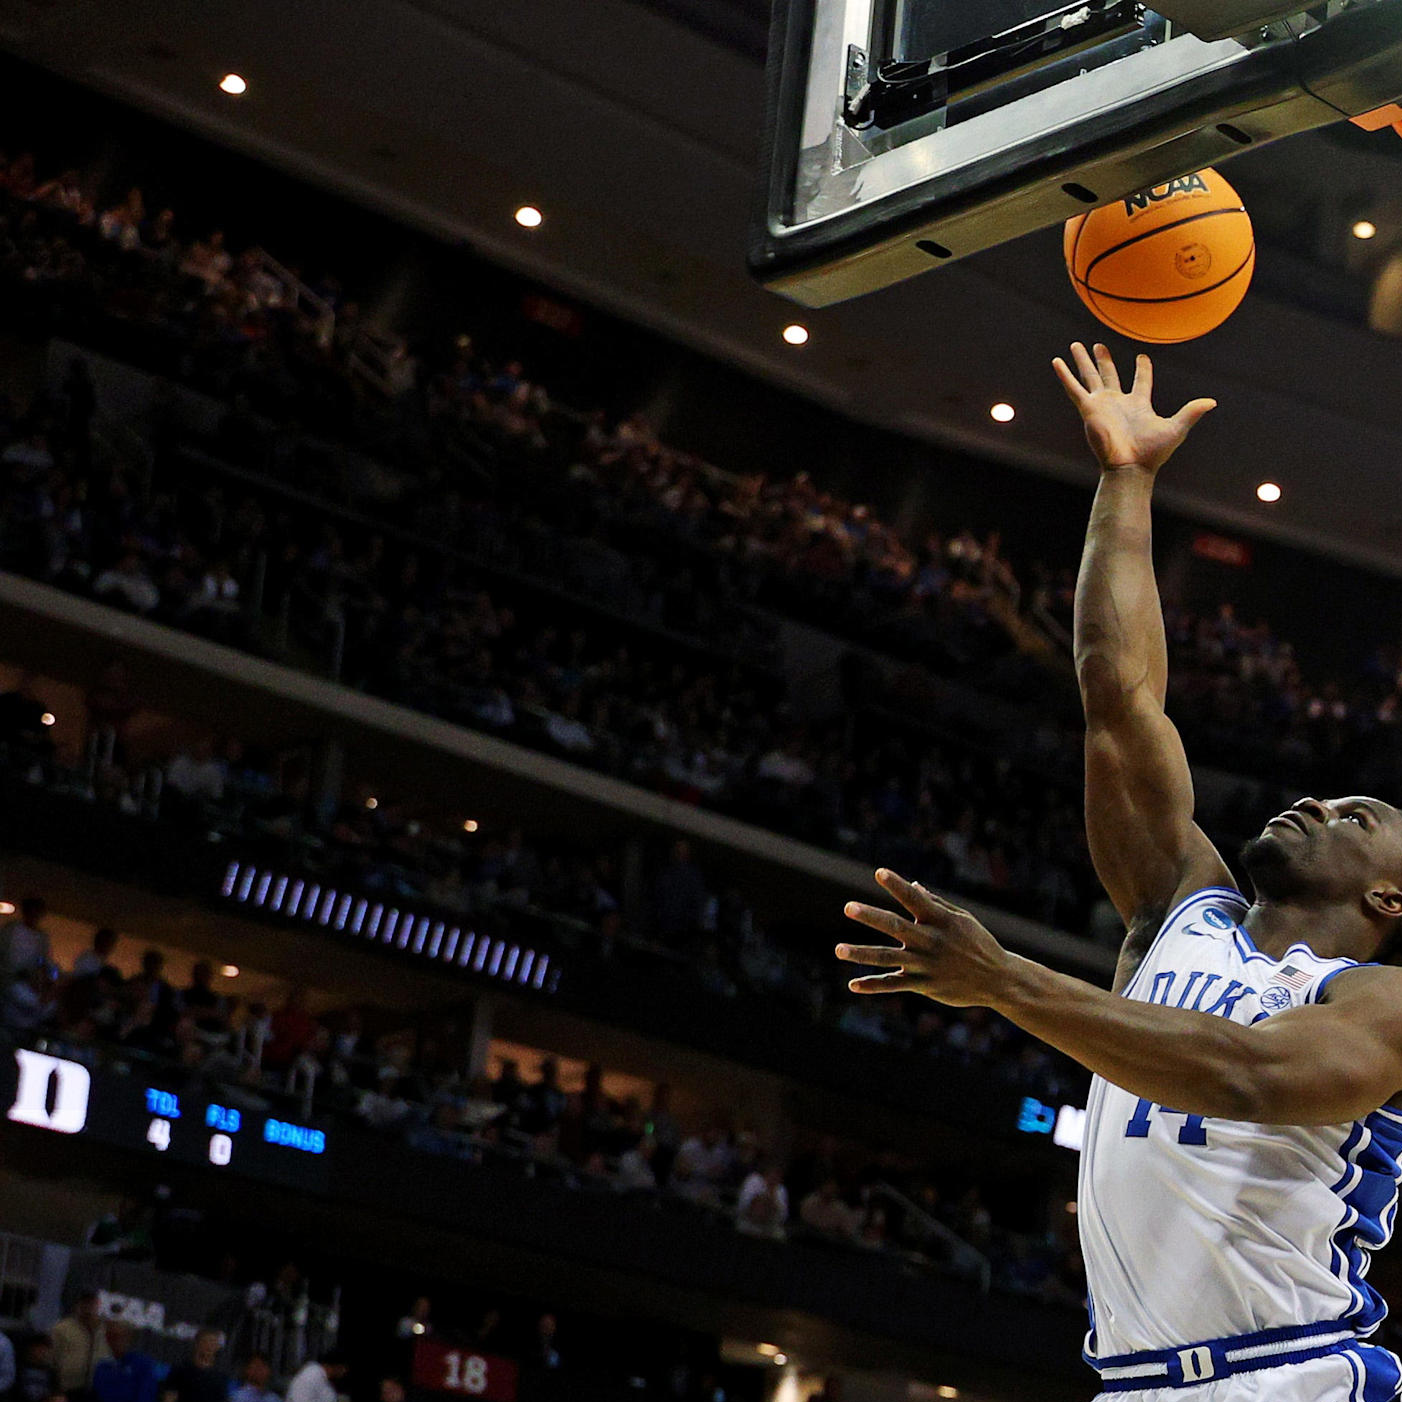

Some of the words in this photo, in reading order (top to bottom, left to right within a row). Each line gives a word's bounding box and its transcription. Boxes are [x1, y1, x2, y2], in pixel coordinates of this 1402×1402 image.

[1151, 971, 1271, 1023] DUK
[209, 1134, 232, 1166] 0
[264, 1118, 326, 1154] BONUS
[445, 1352, 487, 1394] 18
